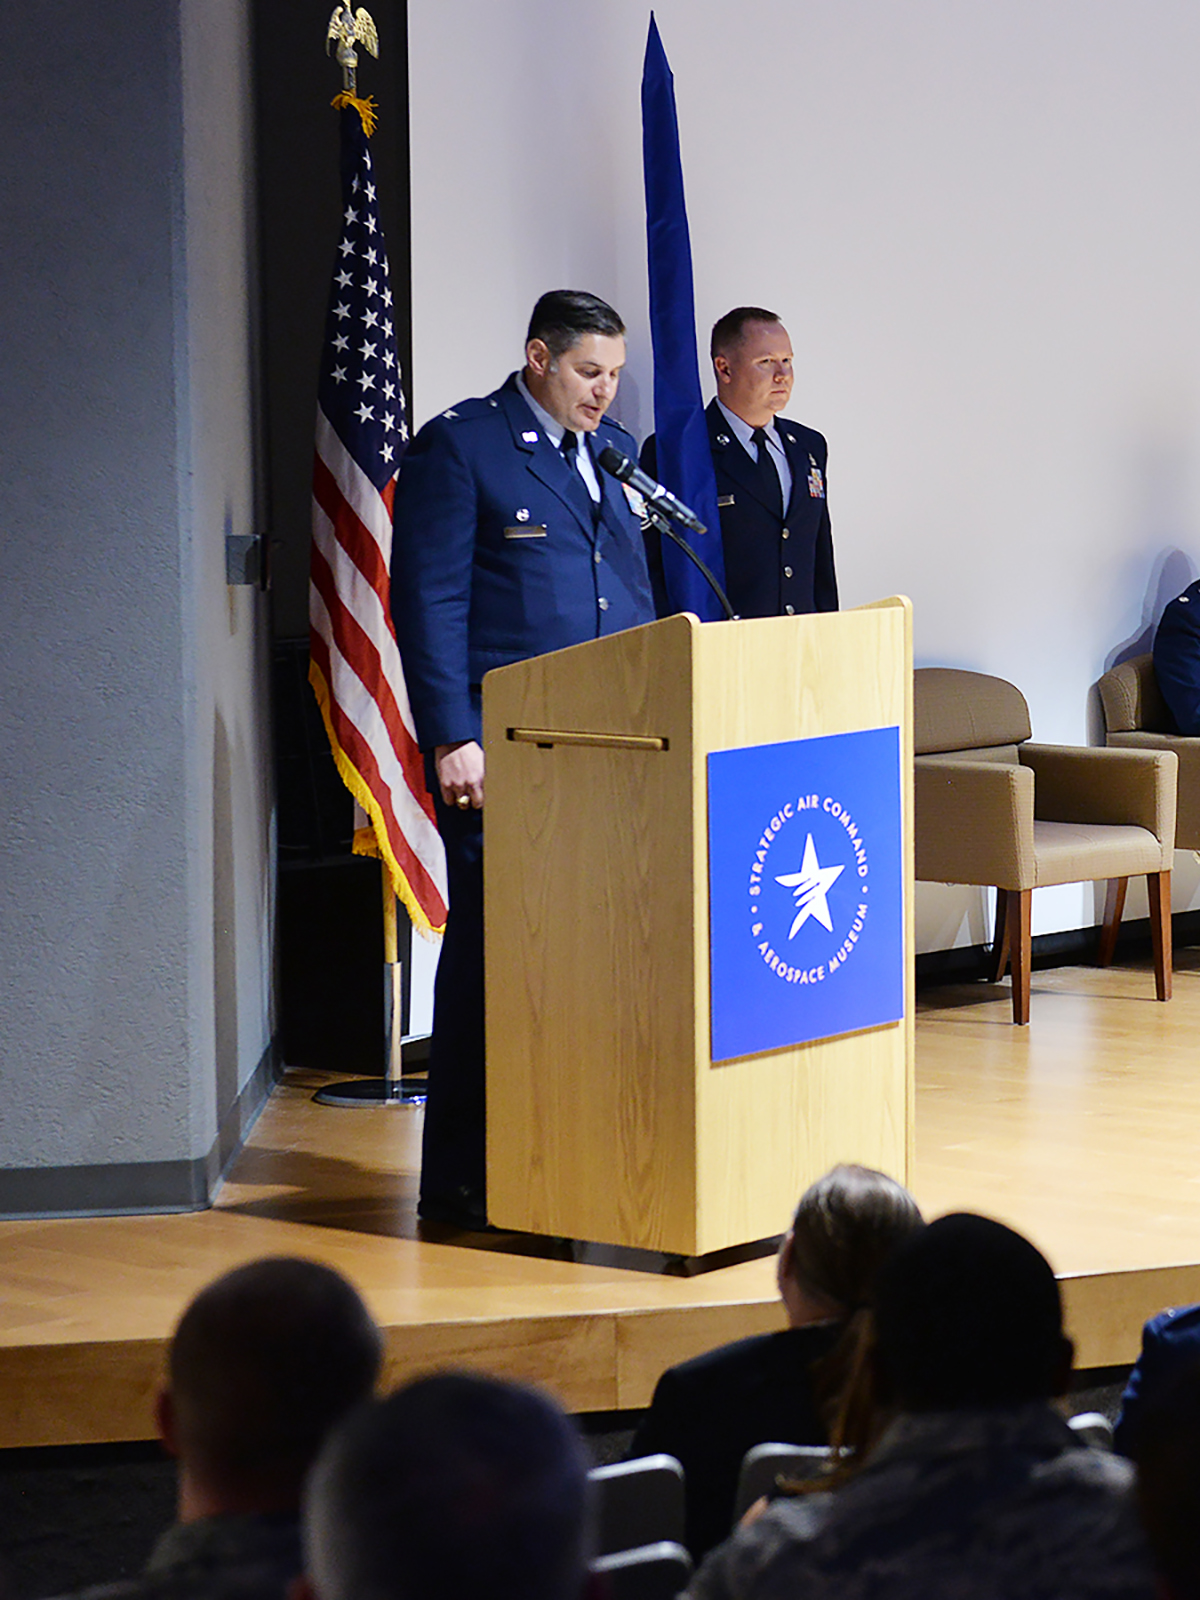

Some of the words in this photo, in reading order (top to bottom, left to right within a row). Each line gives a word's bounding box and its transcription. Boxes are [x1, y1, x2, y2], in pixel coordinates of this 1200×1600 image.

[749, 803, 794, 896] STRATEGIC
[797, 794, 819, 812] AIR
[822, 797, 869, 878] COMMAND
[751, 922, 764, 937] &
[828, 903, 869, 974] MUSEUM
[757, 941, 826, 985] AEROSPACE
